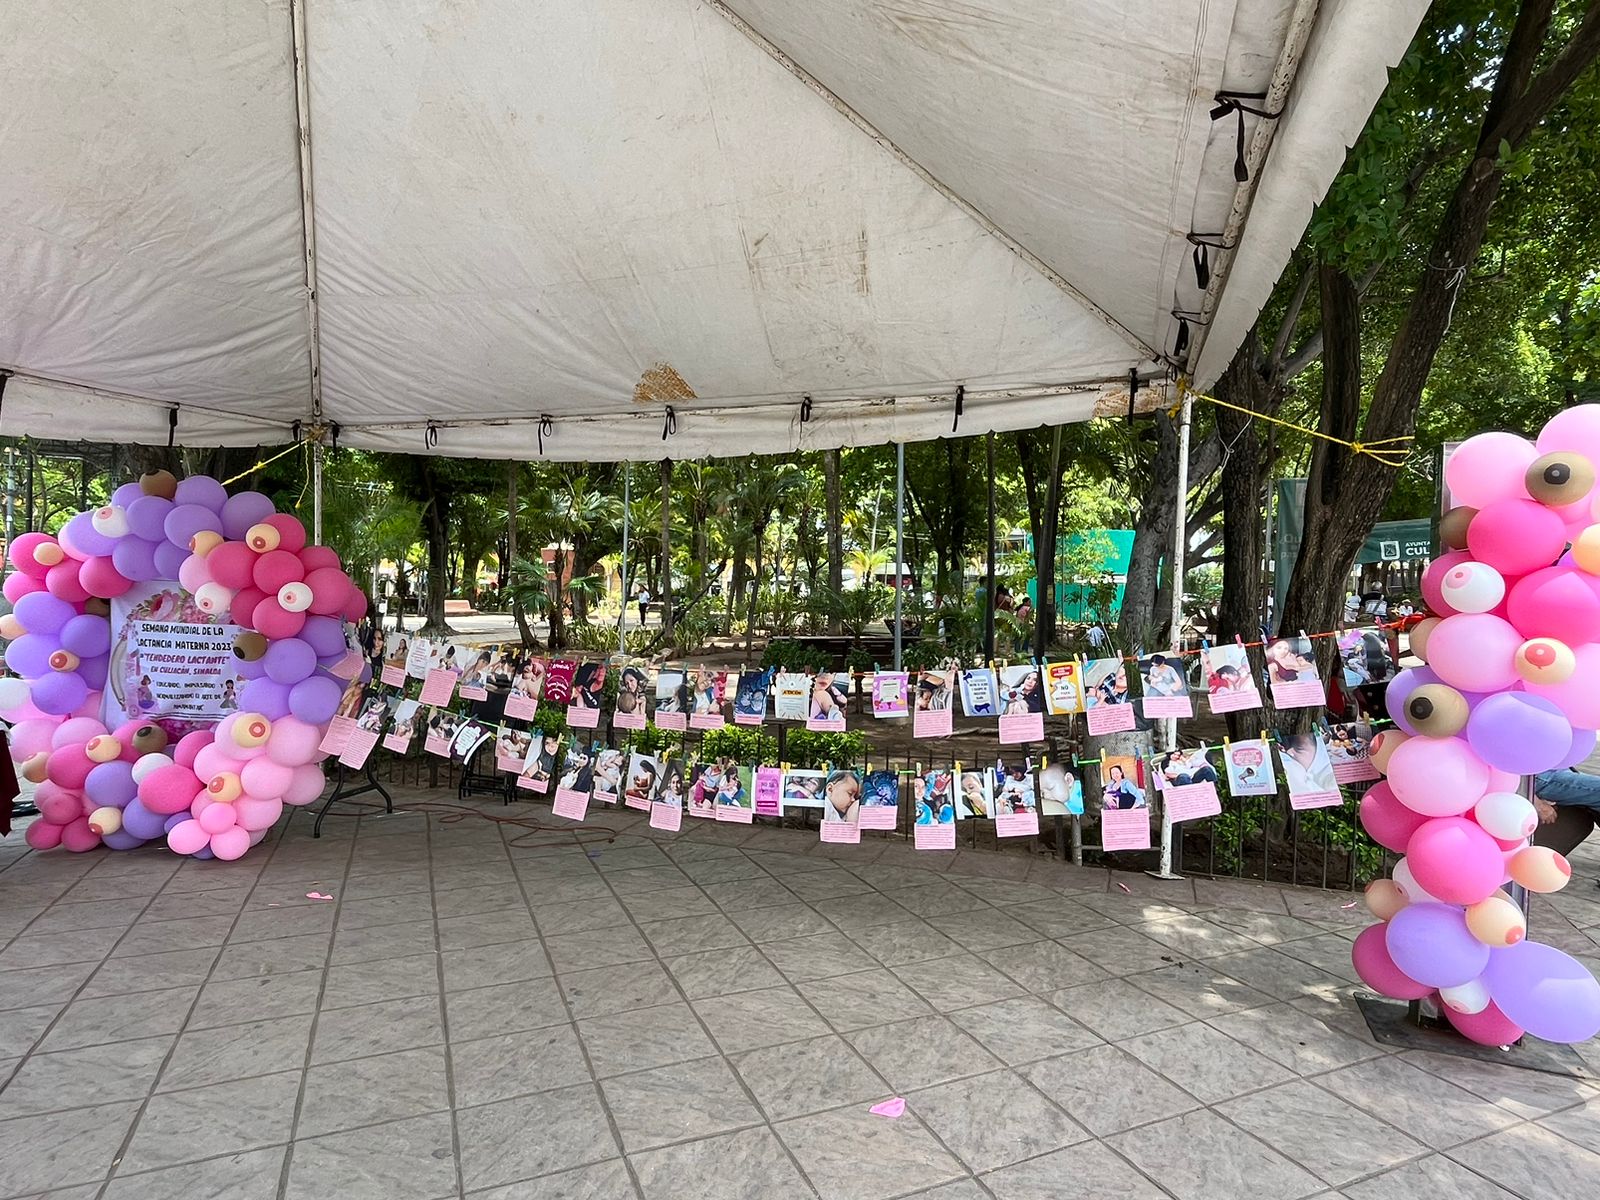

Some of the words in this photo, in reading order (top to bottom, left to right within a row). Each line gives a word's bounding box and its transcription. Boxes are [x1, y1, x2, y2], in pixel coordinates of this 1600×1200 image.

[1405, 546, 1430, 556] CUL
[141, 623, 169, 634] SEMANA
[169, 625, 201, 636] MUNDIAL
[202, 627, 212, 636] DE
[213, 627, 224, 636] LA
[137, 639, 172, 649] LACTANCIA
[175, 641, 210, 651] MATERNA
[211, 642, 232, 651] 2023
[187, 654, 230, 665] LACTANTE"
[193, 667, 222, 676] SINALOA
